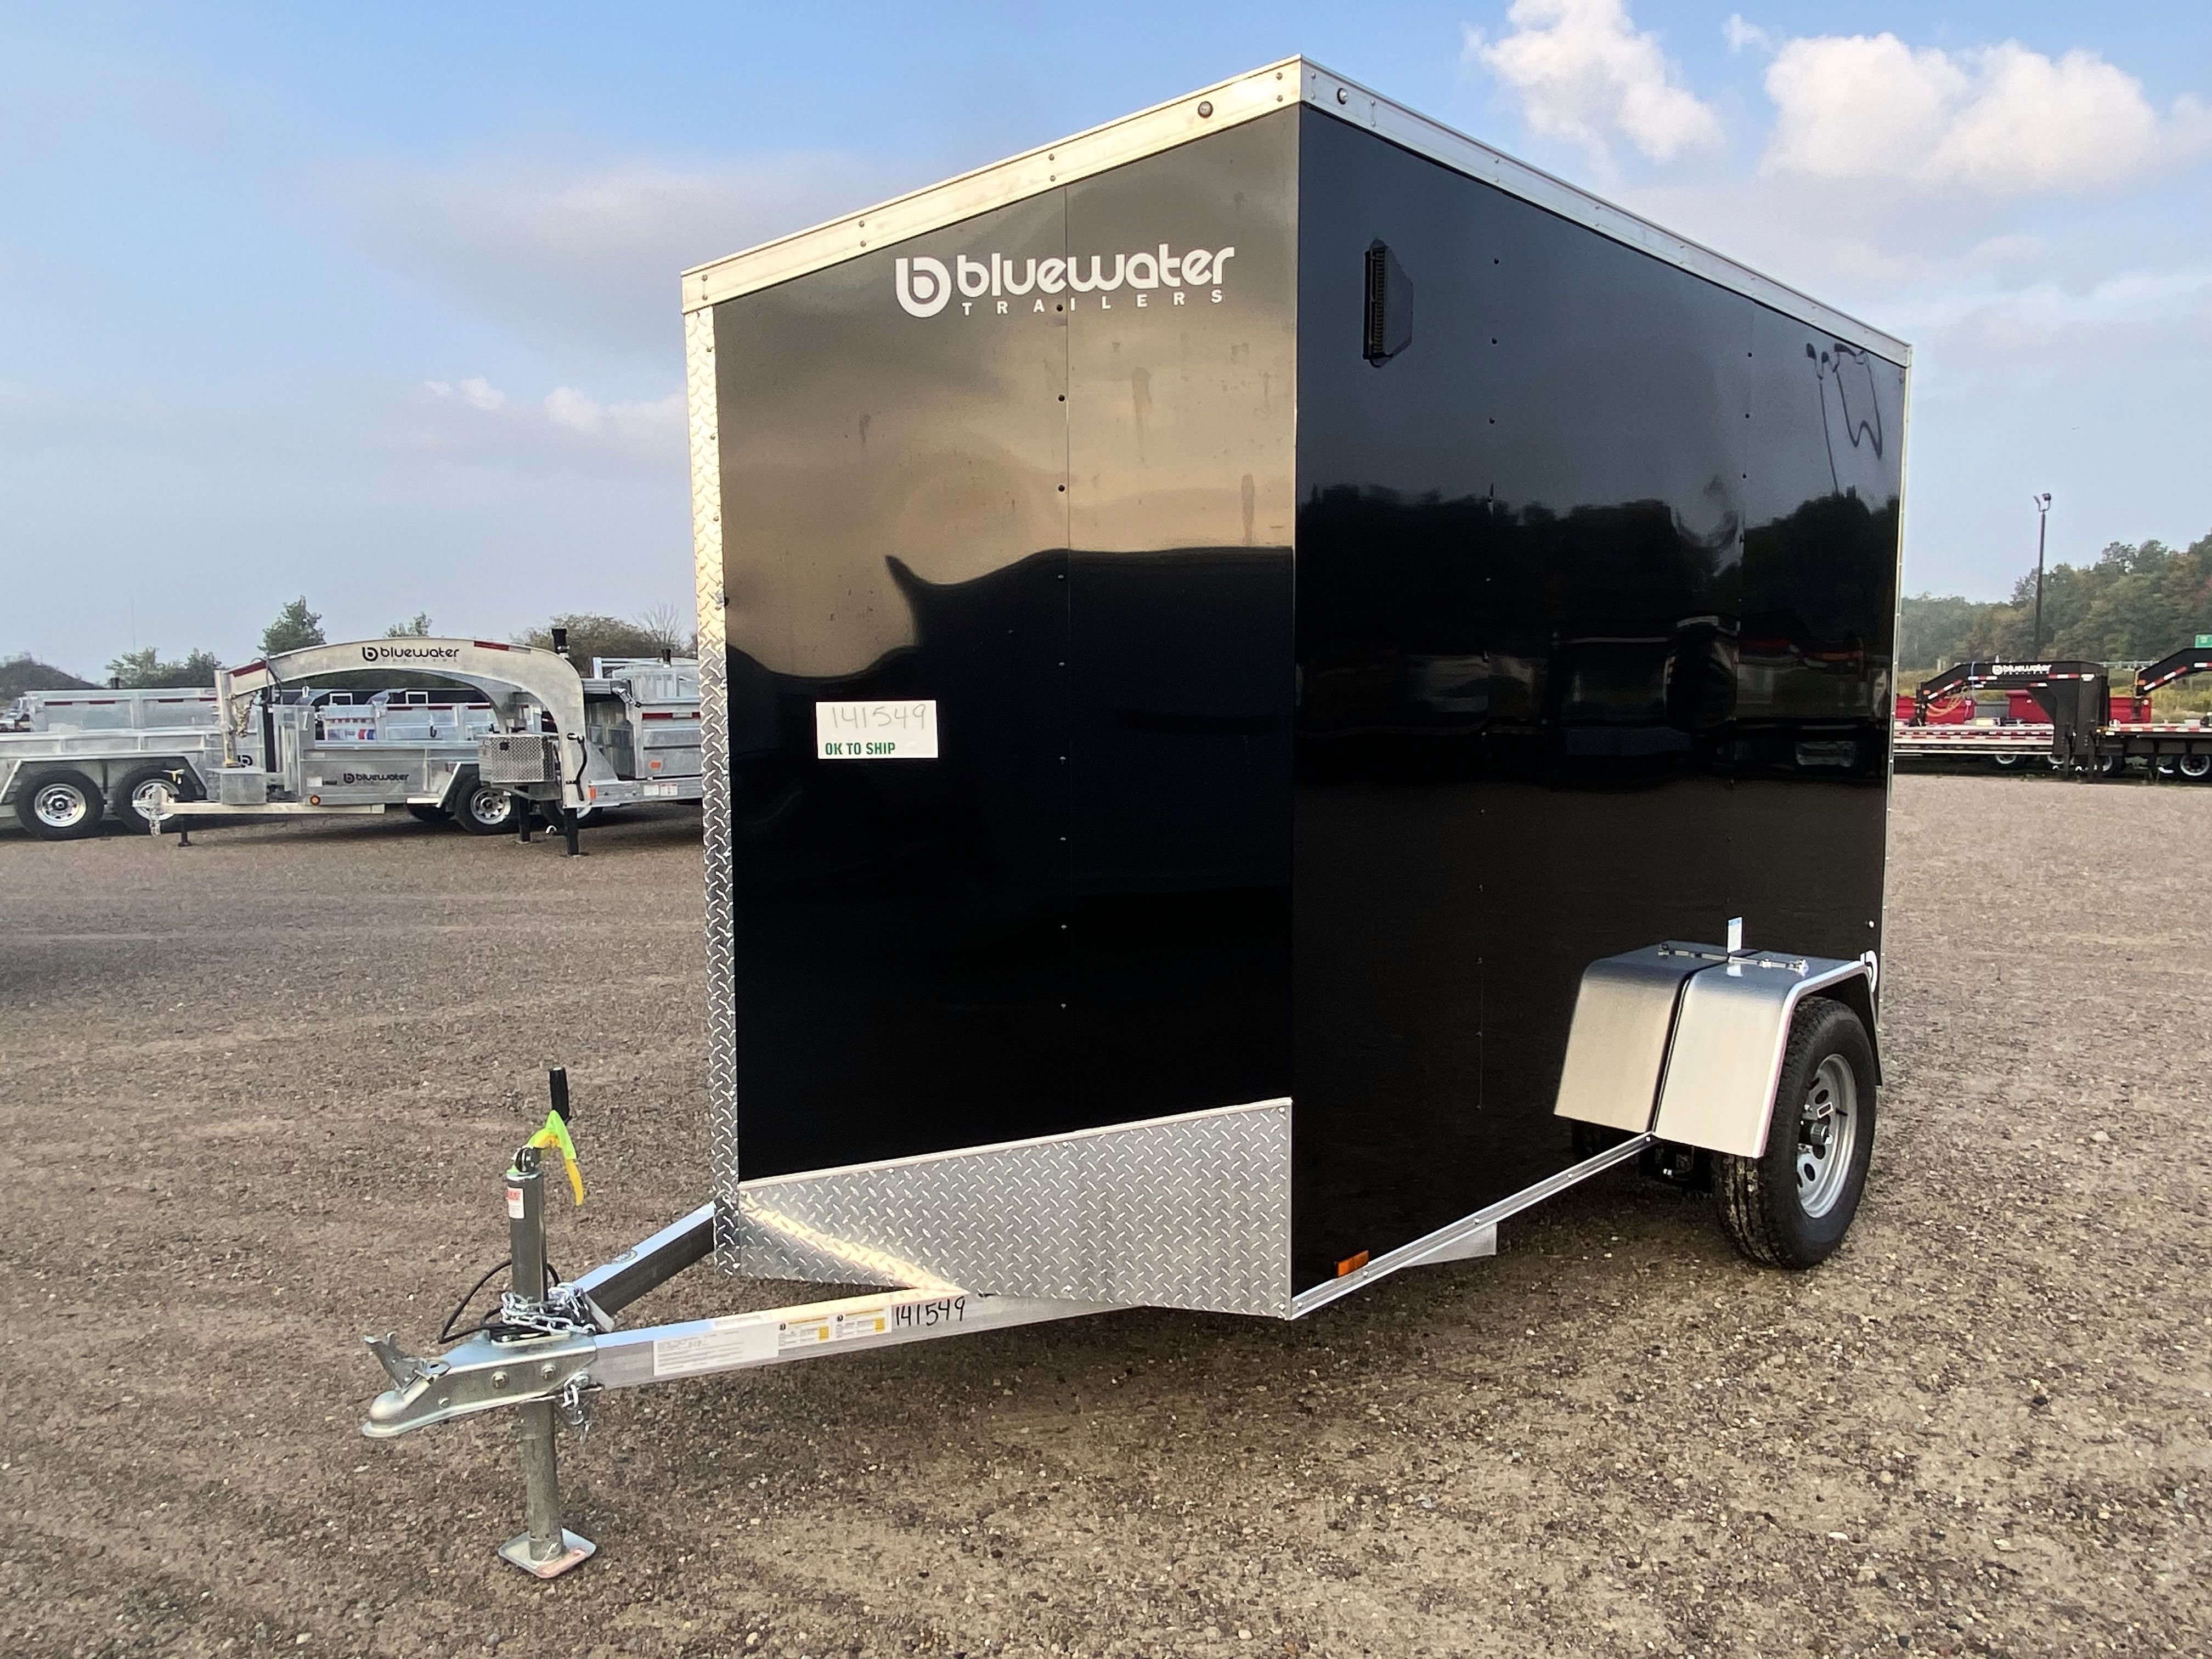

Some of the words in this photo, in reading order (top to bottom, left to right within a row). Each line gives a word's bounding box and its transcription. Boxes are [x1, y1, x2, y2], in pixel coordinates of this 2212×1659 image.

[957, 243, 1235, 298] bluewater
[961, 289, 1223, 316] TRAILERS
[380, 646, 460, 657] bluewater
[832, 704, 926, 730] 141549
[825, 743, 842, 755] OK
[846, 743, 861, 755] TO
[866, 742, 896, 755] SHIP
[356, 773, 409, 781] bluewater
[896, 1295, 966, 1327] 141549
